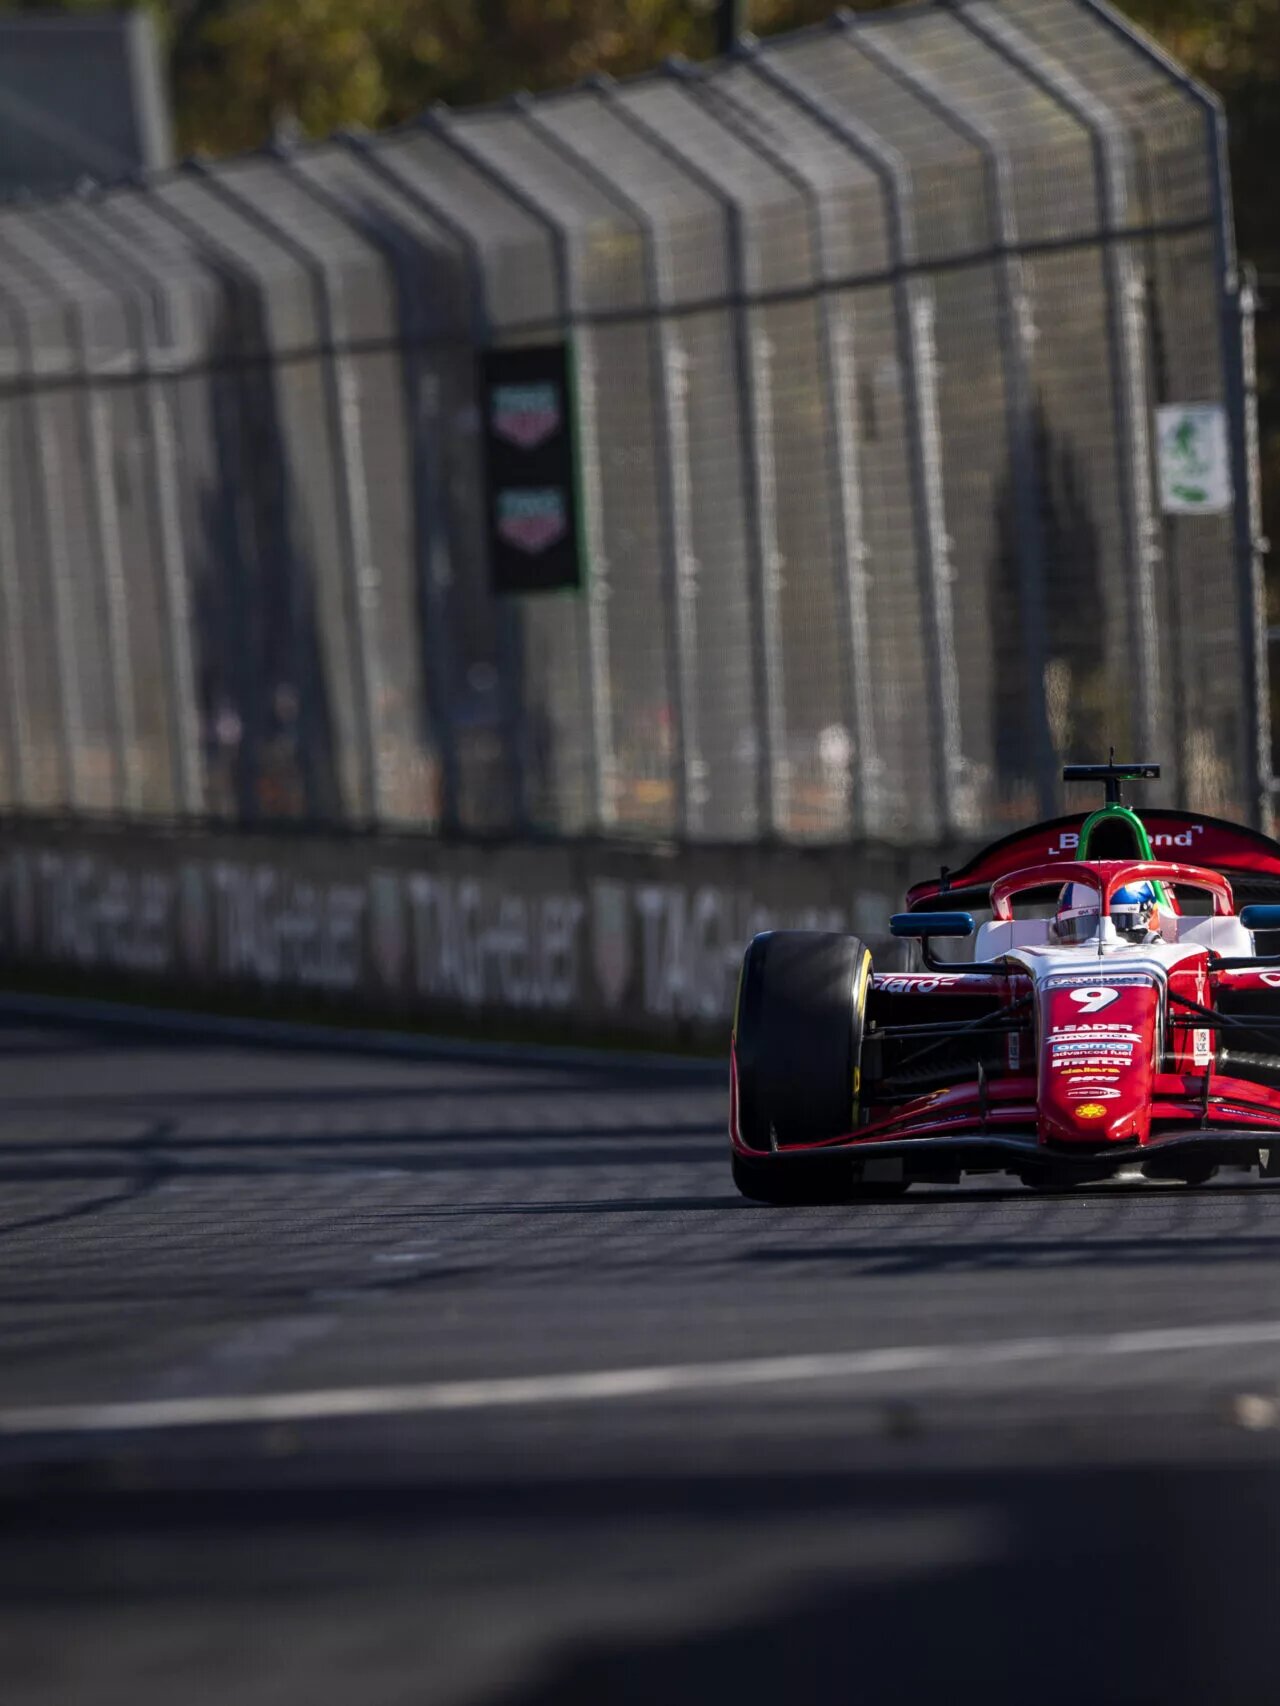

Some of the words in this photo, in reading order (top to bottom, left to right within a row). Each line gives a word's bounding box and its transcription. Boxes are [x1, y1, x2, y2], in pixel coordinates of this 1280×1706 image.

[1069, 987, 1121, 1013] 9
[1052, 1023, 1133, 1033] LEADER
[1056, 1042, 1129, 1051] aramco
[1052, 1049, 1108, 1057] advanced
[1052, 1056, 1132, 1068] PIRELLI
